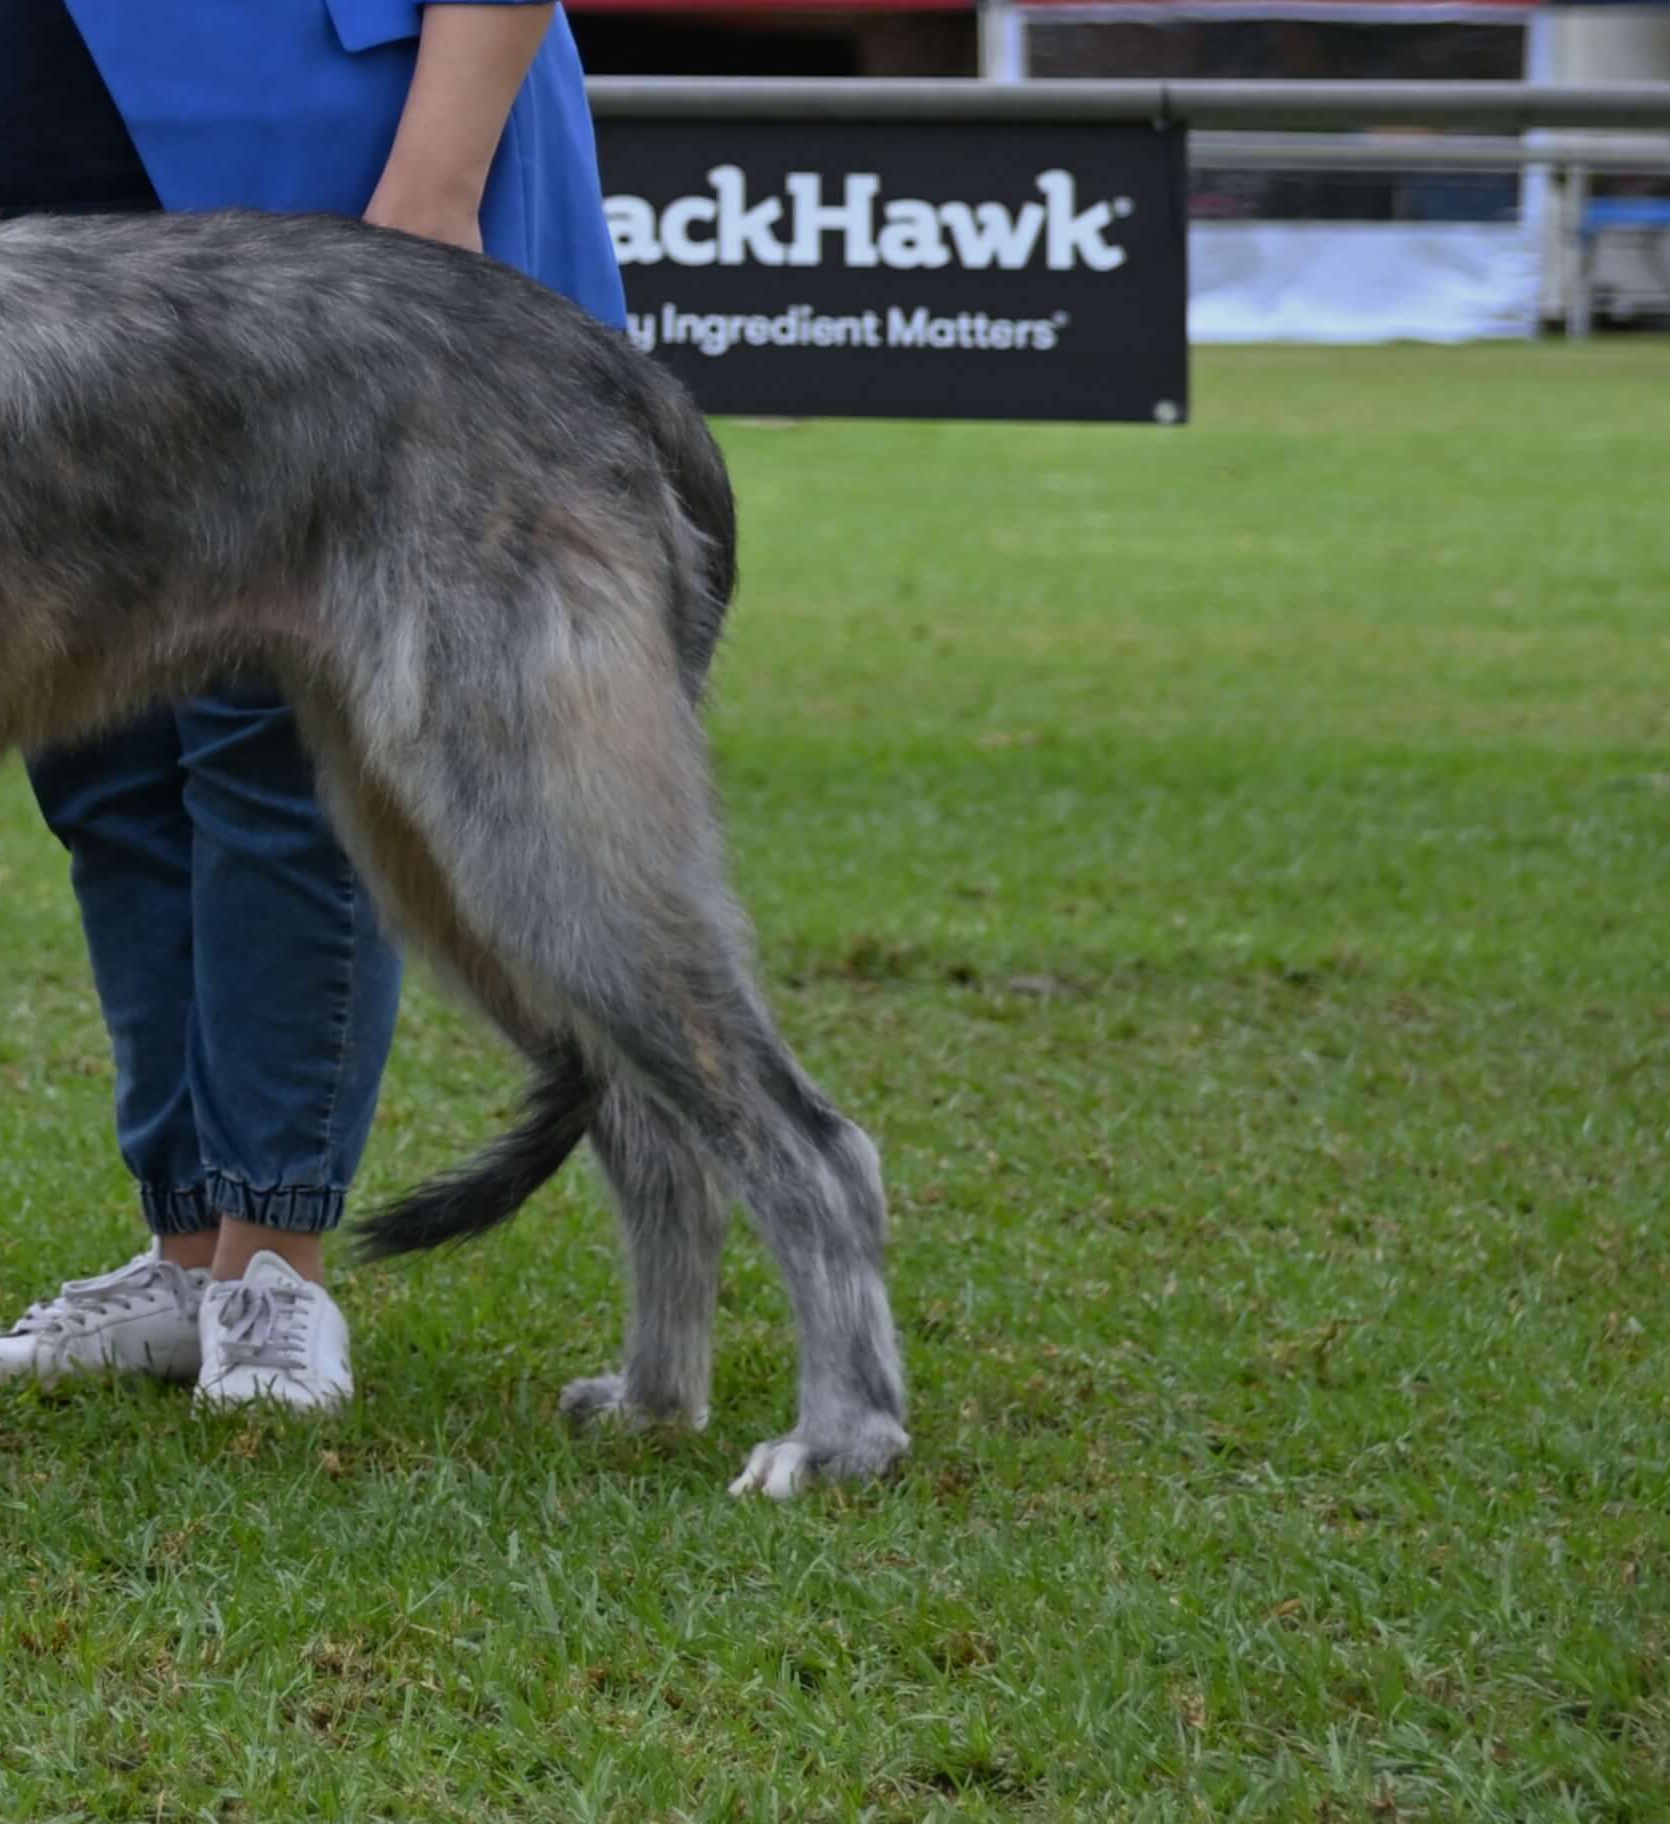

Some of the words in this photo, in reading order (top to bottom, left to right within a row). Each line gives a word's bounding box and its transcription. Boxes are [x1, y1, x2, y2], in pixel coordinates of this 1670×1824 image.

[601, 164, 1127, 271] ackHawk
[662, 302, 883, 356] Ingredient
[887, 305, 1059, 350] Matters
